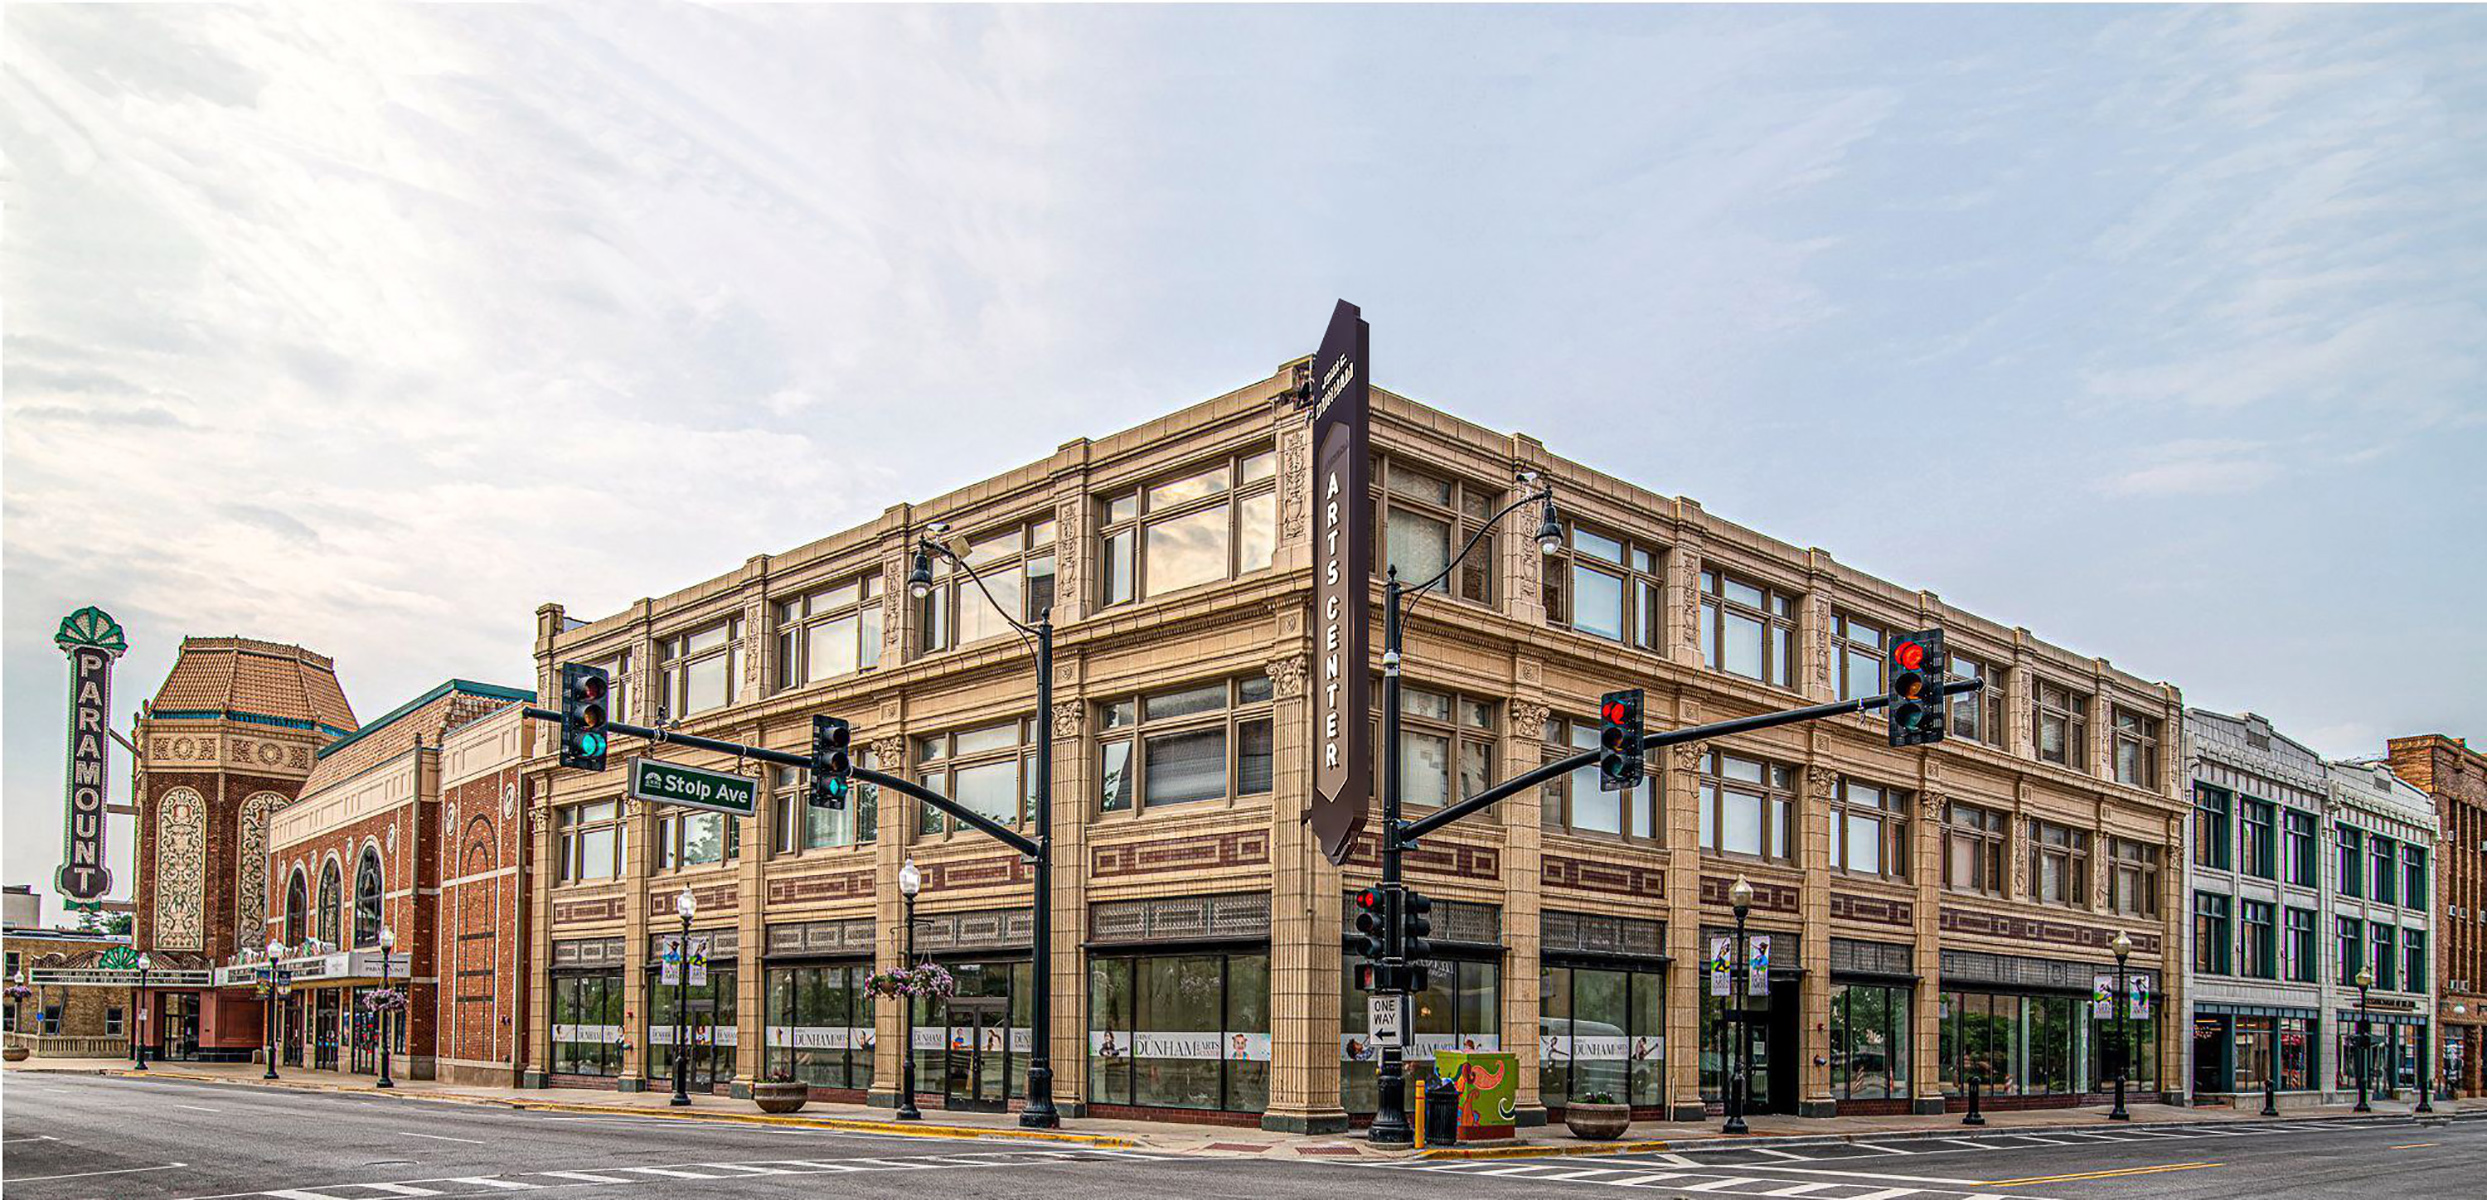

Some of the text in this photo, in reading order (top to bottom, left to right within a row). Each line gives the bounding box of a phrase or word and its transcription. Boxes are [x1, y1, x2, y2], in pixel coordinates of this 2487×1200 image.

[1316, 362, 1354, 421] DUNHAM
[1326, 471, 1340, 586] ARTS
[1325, 595, 1340, 769] CENTER
[74, 653, 103, 894] PARAMOUNT
[664, 774, 749, 804] Stolp Ave
[1374, 1000, 1395, 1012] ONE
[1373, 1013, 1395, 1025] WAY
[795, 1034, 834, 1046] DUNHAM
[1134, 1040, 1197, 1057] DUNHAM
[1201, 1041, 1220, 1051] ARTS
[1402, 1043, 1438, 1057] NHAM
[1573, 1043, 1614, 1056] DUNHAM
